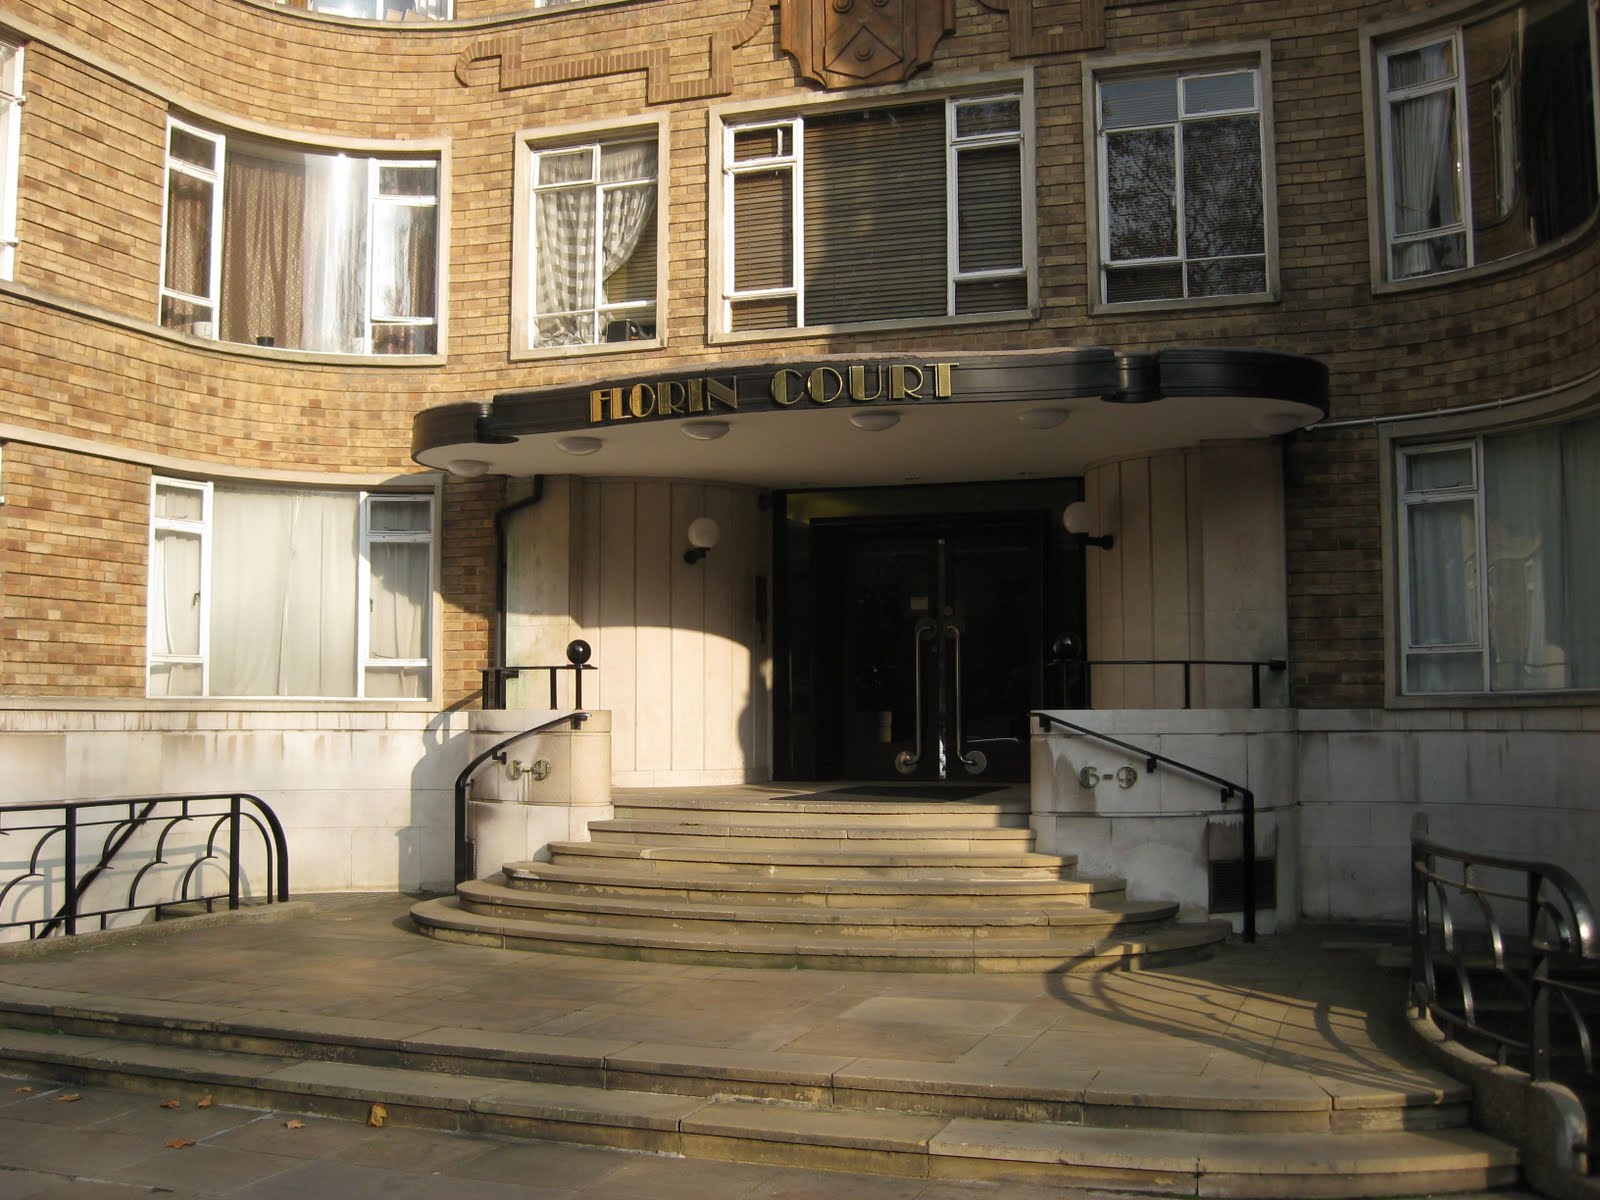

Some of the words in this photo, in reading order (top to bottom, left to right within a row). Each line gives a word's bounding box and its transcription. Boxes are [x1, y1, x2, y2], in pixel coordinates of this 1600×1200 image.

[590, 375, 738, 423] FLORIN
[770, 362, 960, 405] COURT
[1080, 766, 1137, 788] 6-9
